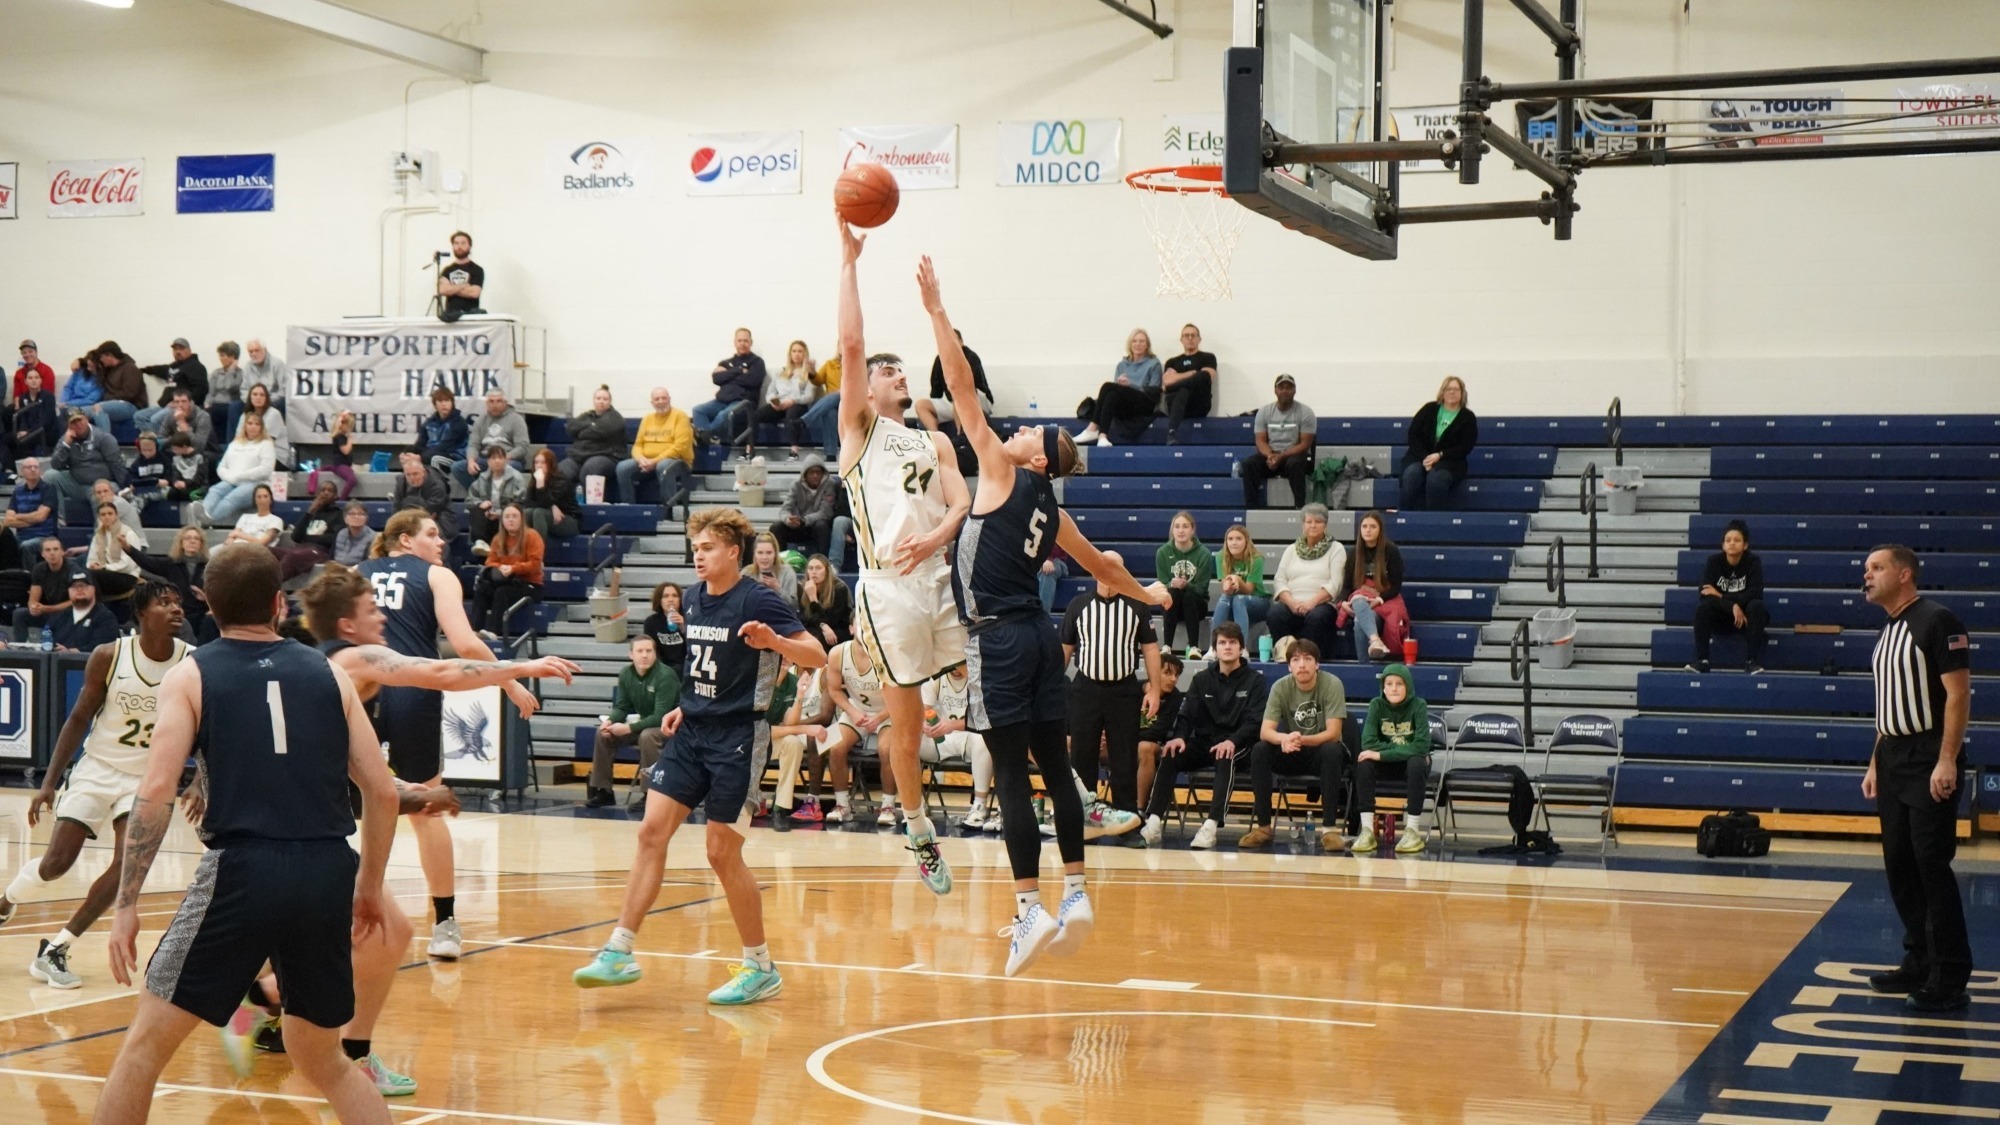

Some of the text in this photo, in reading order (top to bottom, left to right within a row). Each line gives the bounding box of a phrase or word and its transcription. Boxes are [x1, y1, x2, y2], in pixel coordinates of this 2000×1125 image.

[1763, 98, 1831, 113] TOUGH
[1528, 137, 1638, 156] TRILERS
[728, 149, 798, 177] pepsi
[1016, 161, 1100, 184] MIDCO
[50, 167, 139, 205] Coca-Cola
[185, 174, 267, 188] DACOTAH BANK
[563, 171, 634, 190] Badlands
[305, 335, 491, 356] SUPPORTING
[293, 368, 376, 399] BLUE
[902, 461, 934, 496] 24
[1023, 507, 1048, 558] 5
[371, 572, 408, 610] 55
[690, 644, 718, 680] 24
[694, 681, 717, 698] STATE
[859, 693, 872, 707] 2
[266, 680, 288, 755] 1
[1467, 720, 1518, 729] Dickinson State
[1562, 721, 1613, 730] Dickinson State
[118, 718, 156, 749] 23
[1475, 727, 1508, 736] University
[1570, 728, 1603, 737] University
